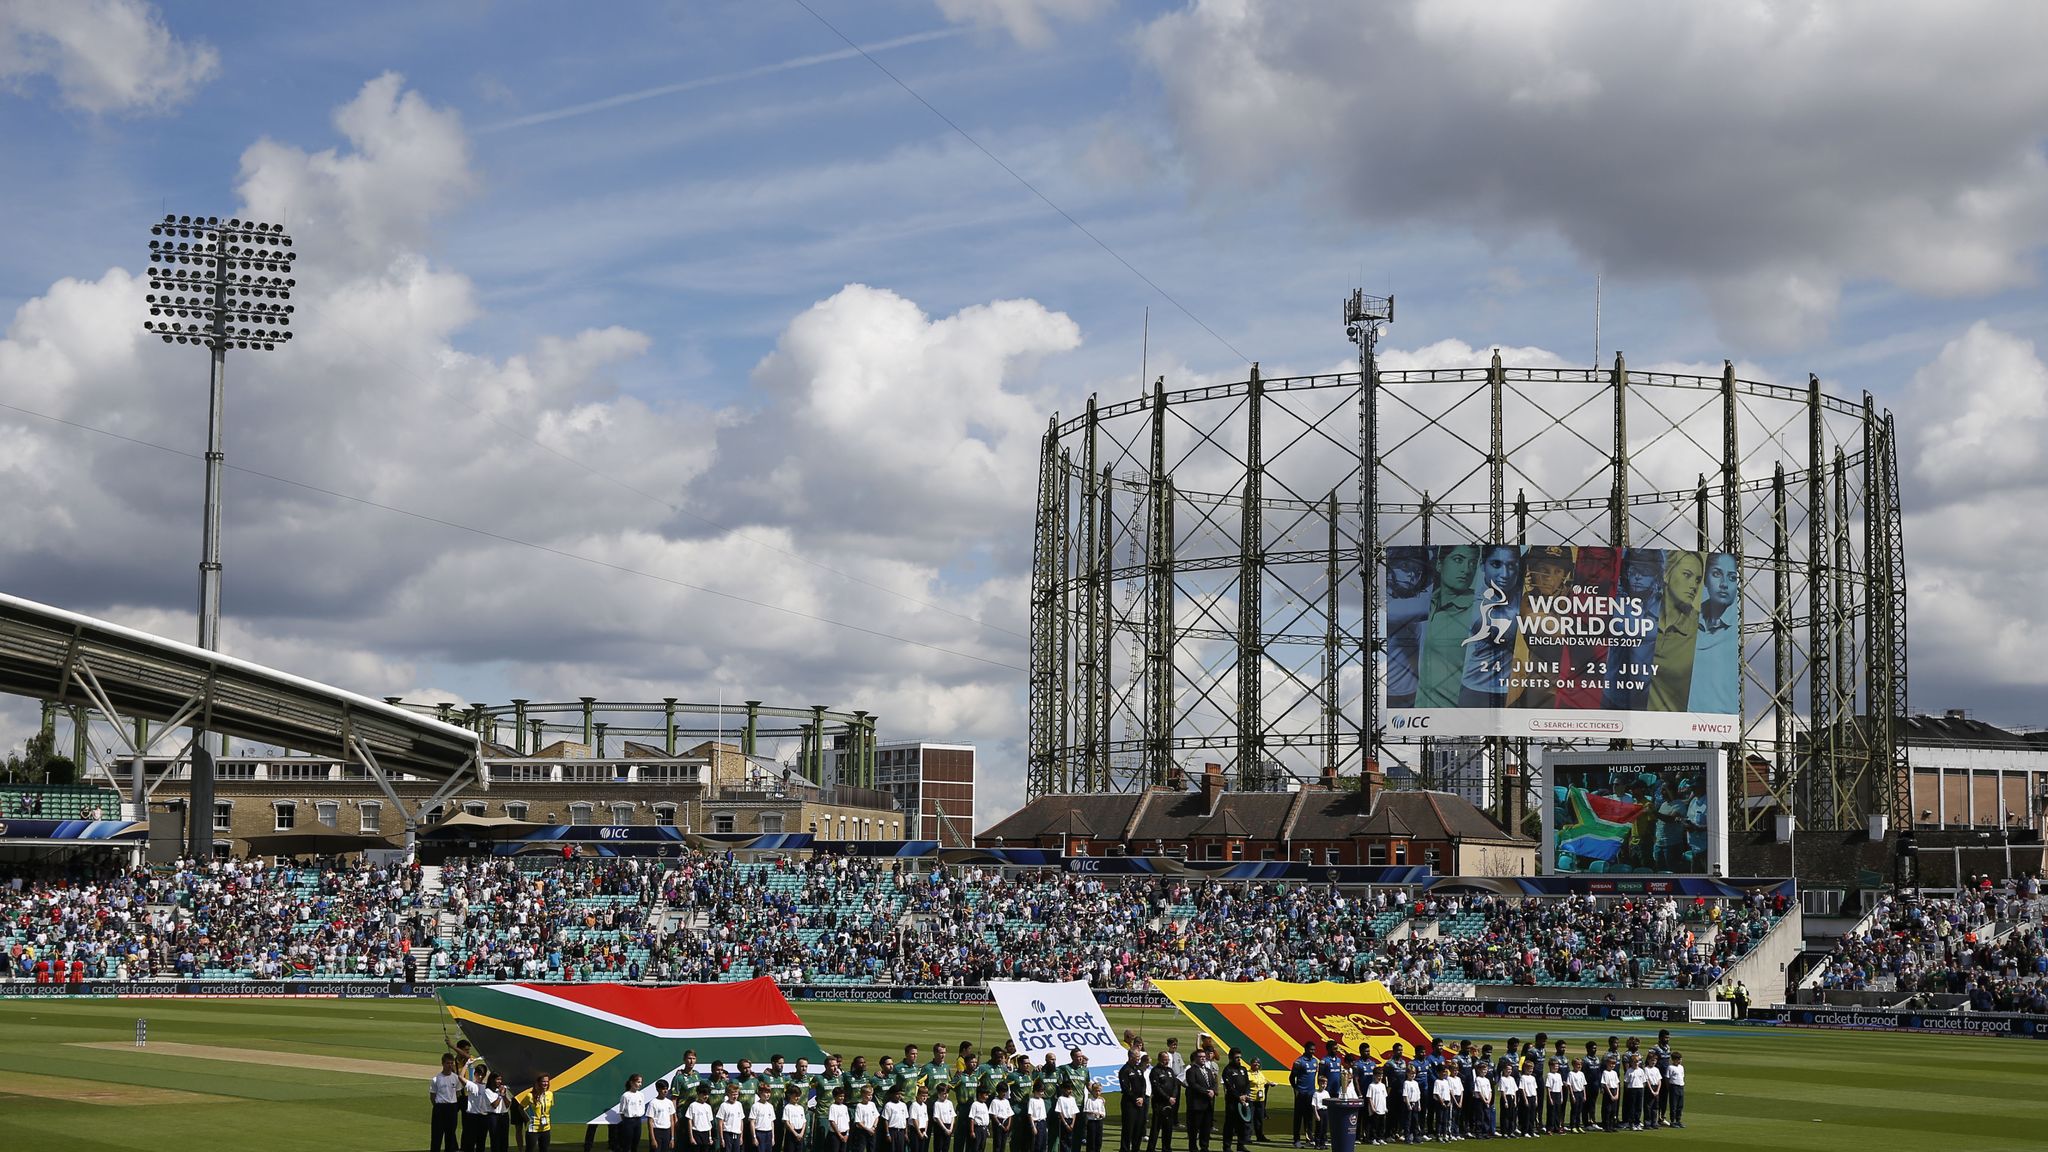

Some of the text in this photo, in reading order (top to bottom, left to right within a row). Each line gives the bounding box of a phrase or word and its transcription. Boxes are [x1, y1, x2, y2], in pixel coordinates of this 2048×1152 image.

[1583, 585, 1599, 594] ICC
[1528, 595, 1643, 616] WOMEN'S
[1516, 615, 1655, 637] WORLD CUP
[1529, 636, 1643, 648] ENGLAND & WALES 2017
[1480, 661, 1501, 672] 24
[1512, 661, 1559, 673] JUNE
[1586, 662, 1608, 674] 23
[1618, 663, 1659, 676] JULY
[1499, 678, 1645, 690] TICKETS ON SALE NOW
[1407, 716, 1430, 728] ICC
[1544, 721, 1574, 729] SEARCH:
[1691, 723, 1732, 734] #WWC17
[1608, 765, 1646, 773] HUBLOT
[611, 828, 629, 839] ICC
[1081, 860, 1100, 871] ICC
[20, 983, 37, 994] for
[37, 984, 66, 995] good
[91, 983, 178, 995] cricket for good
[201, 984, 284, 995] cricket for good
[309, 984, 390, 995] cricket for good
[815, 988, 891, 1000] cricket for good
[913, 989, 989, 1001] cricket for good
[1108, 993, 1142, 1004] cricket
[1144, 994, 1159, 1004] for
[1404, 1001, 1484, 1013] cricket for good
[1507, 1003, 1588, 1016] cricket for good
[1610, 1005, 1644, 1017] cricket
[1646, 1006, 1662, 1018] for
[1021, 1010, 1099, 1033] cricket
[1814, 1011, 1898, 1026] cricket for good
[1923, 1016, 2011, 1032] cricket for good
[1018, 1027, 1116, 1052] for good
